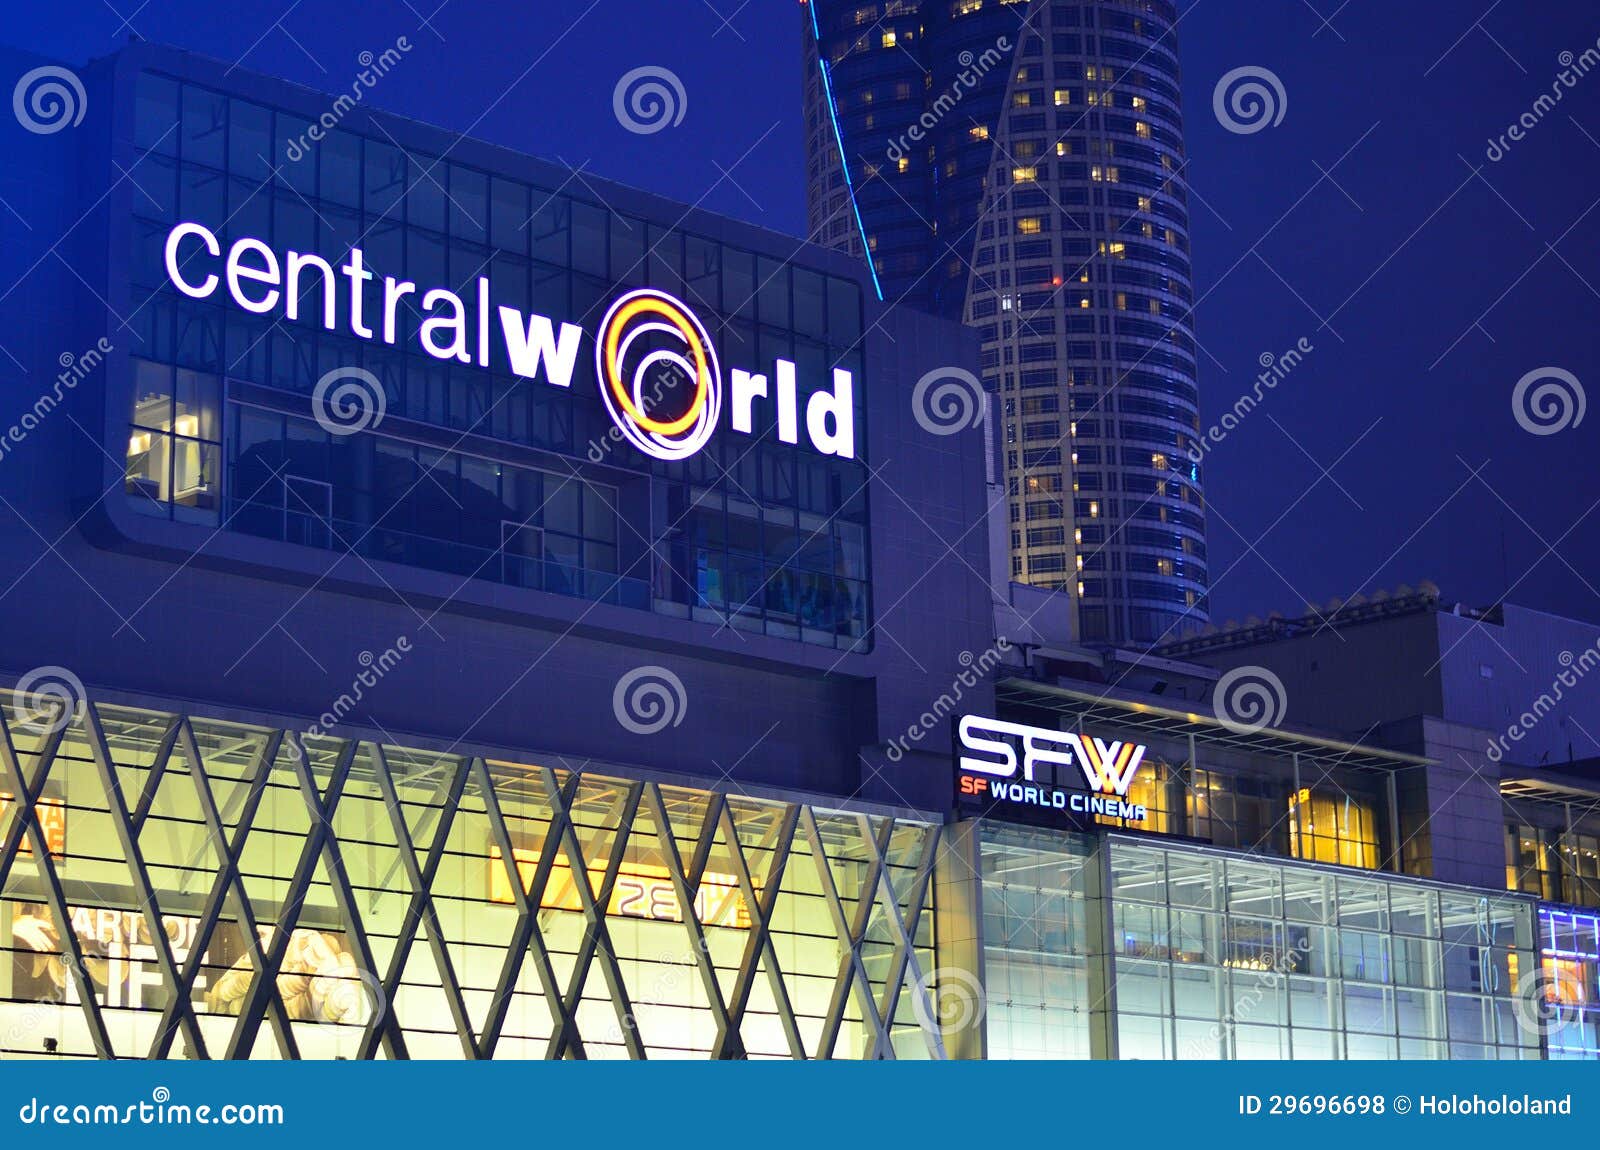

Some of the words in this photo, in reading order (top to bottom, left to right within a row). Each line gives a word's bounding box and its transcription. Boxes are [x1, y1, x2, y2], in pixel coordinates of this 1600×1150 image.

[960, 775, 988, 795] SF
[990, 780, 1066, 809] WORLD
[1070, 794, 1147, 821] CINEMA
[71, 907, 146, 944] ART
